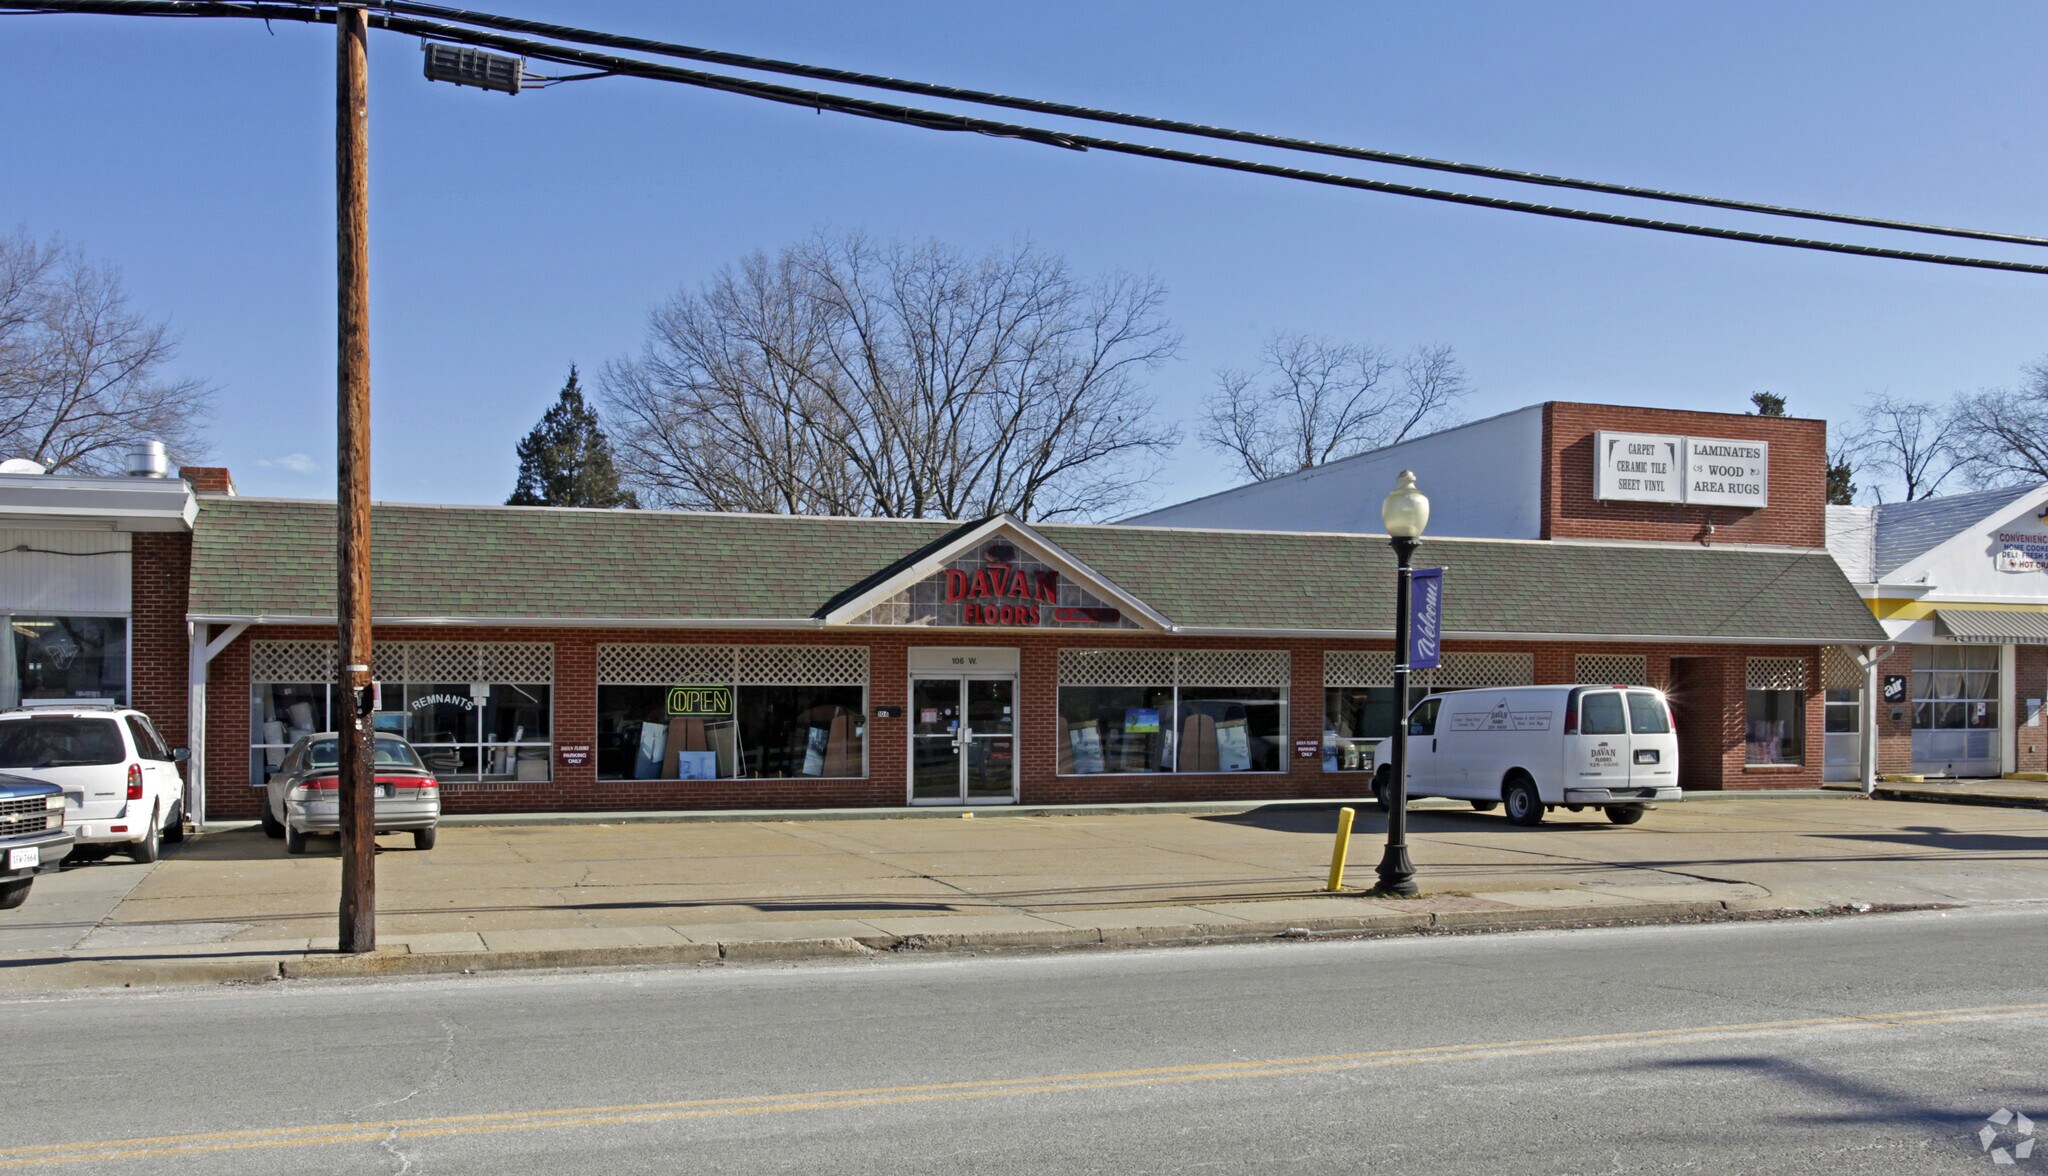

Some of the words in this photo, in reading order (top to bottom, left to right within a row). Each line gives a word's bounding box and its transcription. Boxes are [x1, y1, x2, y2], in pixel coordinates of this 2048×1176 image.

[1628, 443, 1655, 456] CARPET
[1693, 444, 1760, 459] LAMINATES
[1617, 460, 1647, 474] CERAMIC
[1651, 462, 1667, 474] TILE
[1708, 465, 1744, 477] WOOD
[1618, 478, 1641, 491] SHEET
[1644, 479, 1665, 492] VINYL
[1693, 481, 1725, 493] AREA
[1728, 483, 1760, 494] RUGS
[2000, 533, 2048, 543] CONVENIENC
[2002, 551, 2018, 559] DELI
[2019, 560, 2034, 568] HOT
[944, 564, 1059, 605] DAVAN
[964, 603, 1040, 626] FLOORS
[1417, 578, 1438, 660] Welcome
[952, 657, 965, 665] 106
[968, 657, 978, 665] W.
[1884, 677, 1902, 697] air
[411, 693, 475, 711] REMNANTS
[673, 690, 727, 712] OPEN
[1591, 747, 1616, 758] DAVAN
